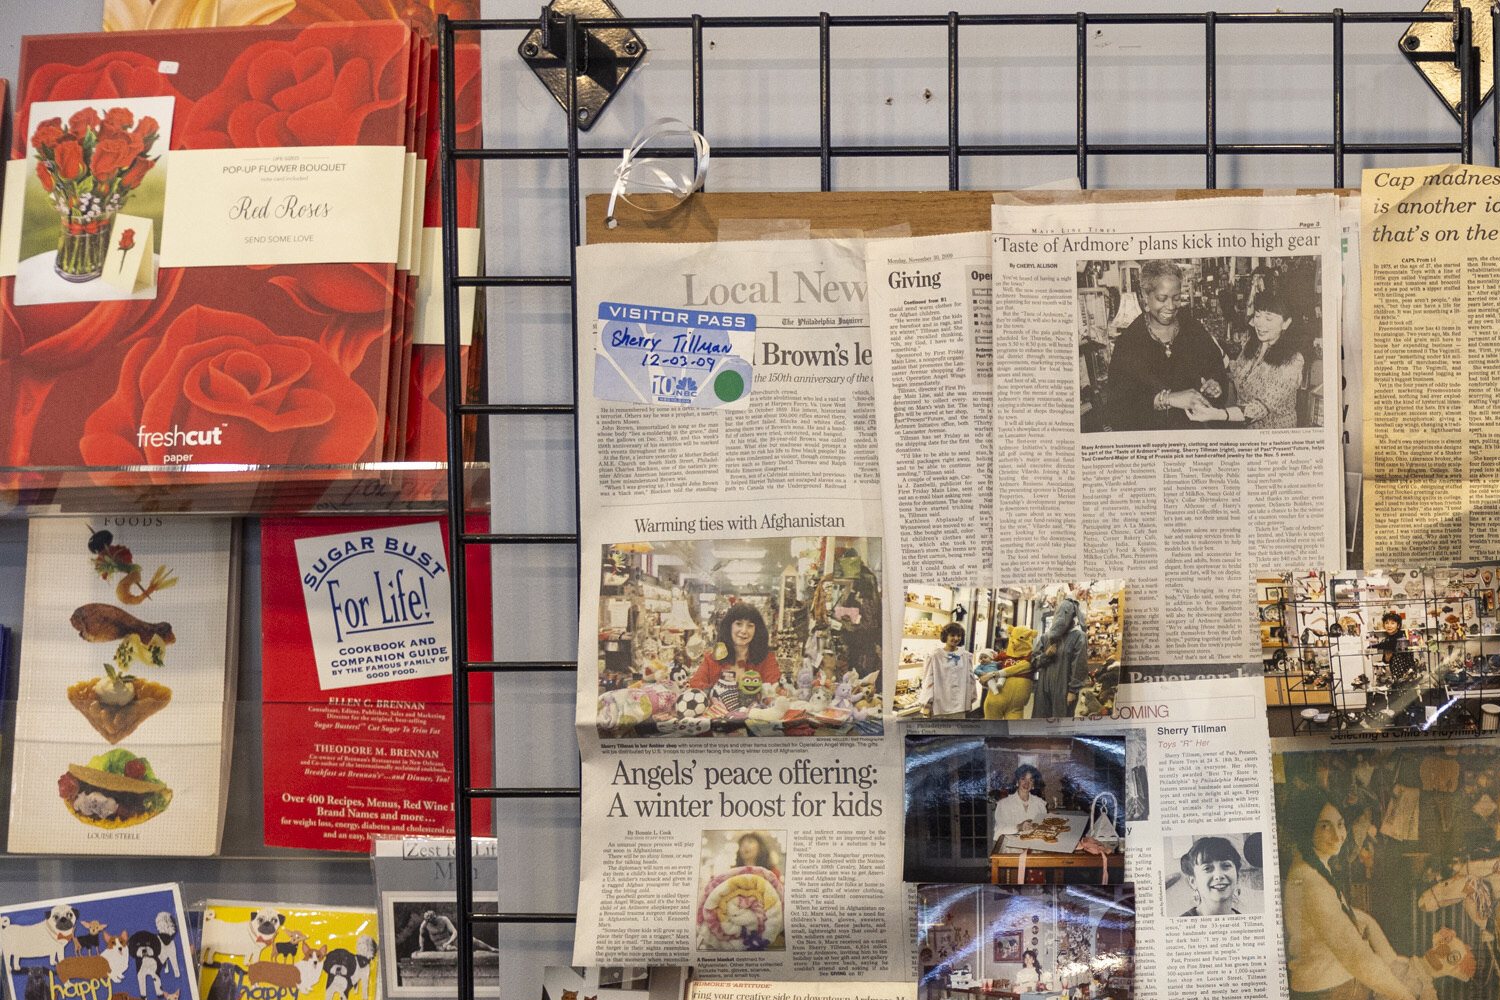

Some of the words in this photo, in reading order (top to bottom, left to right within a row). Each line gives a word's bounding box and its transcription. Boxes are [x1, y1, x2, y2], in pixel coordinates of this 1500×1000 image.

[223, 166, 256, 174] POP-UP
[259, 164, 297, 172] FLOWER
[300, 164, 346, 172] BOUQUET
[1375, 173, 1414, 190] Cap
[229, 196, 272, 219] Red
[275, 193, 333, 219] Roses
[1374, 198, 1389, 213] is
[1398, 197, 1476, 214] another
[244, 236, 266, 244] SEND
[268, 235, 292, 244] SOME
[293, 234, 314, 243] LOVE
[1373, 225, 1429, 242] that's
[1436, 230, 1459, 241] on
[1467, 224, 1498, 240] the
[1044, 237, 1059, 252] of
[1062, 236, 1133, 252] Ardmore'
[1139, 236, 1177, 254] plans
[1183, 234, 1212, 249] kick
[1218, 233, 1246, 247] into
[1252, 232, 1282, 251] high
[1288, 236, 1320, 251] gear
[682, 271, 780, 306] Local
[888, 271, 941, 289] Giving
[610, 306, 688, 324] VISITOR
[698, 315, 745, 327] PASS
[612, 327, 661, 352] Sherry
[673, 332, 732, 354] Tillman
[642, 354, 715, 372] 12-03-09
[762, 342, 848, 366] Brown's
[675, 389, 697, 397] NBC
[164, 455, 193, 464] paper
[105, 514, 166, 526] FOODS
[635, 518, 696, 534] Warming
[700, 516, 723, 530] ties
[728, 515, 757, 530] with
[760, 513, 844, 530] Afghanistan
[304, 536, 375, 589] SUGAR
[385, 537, 445, 578] BUST
[327, 580, 368, 643] For
[374, 569, 431, 624] Life!
[339, 641, 405, 656] COOKBOOK
[411, 637, 436, 646] AND
[331, 652, 405, 669] COMPANION
[409, 647, 447, 658] GUIDE
[1158, 727, 1188, 736] Sherry
[1192, 725, 1226, 733] Tillman
[314, 745, 372, 757] THEODORE
[376, 748, 387, 756] M.
[390, 748, 438, 758] BRENNAN
[612, 760, 696, 790] Angels'
[704, 768, 772, 790] peace
[779, 759, 877, 789] offering:
[607, 792, 628, 817] A
[634, 792, 713, 817] winter
[719, 792, 785, 817] boost
[792, 792, 826, 816] for
[832, 791, 882, 816] kids
